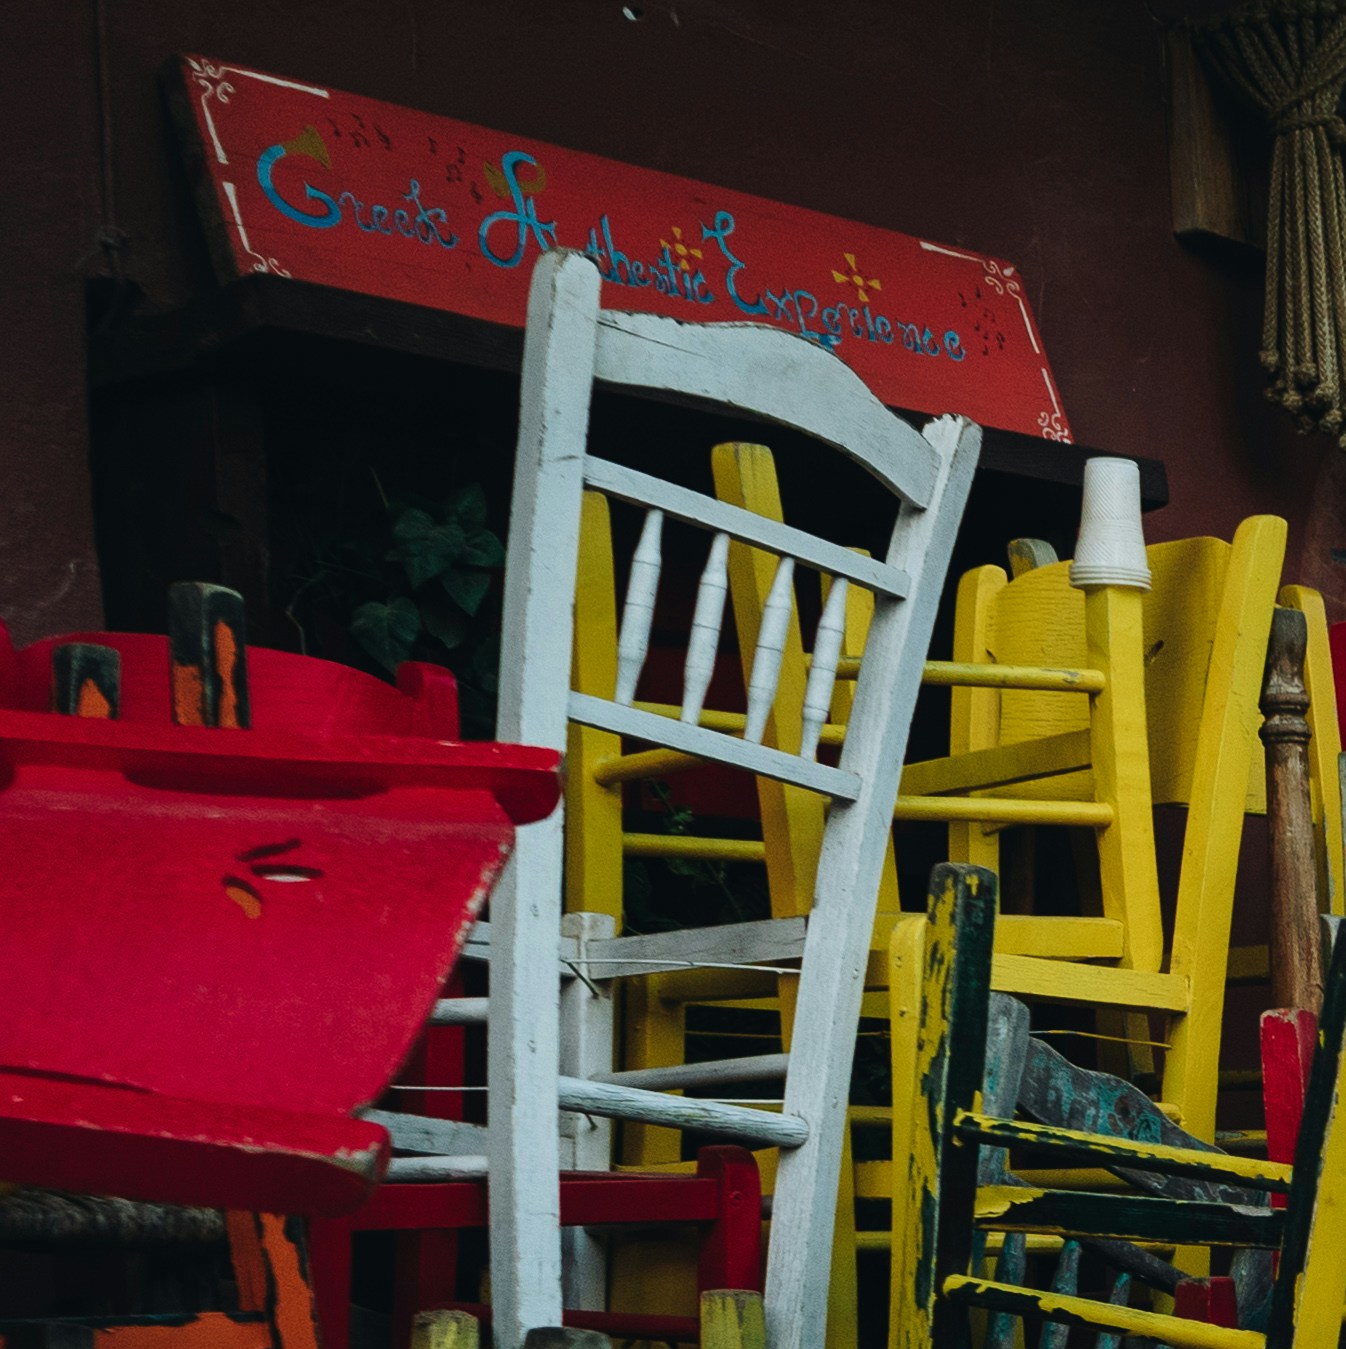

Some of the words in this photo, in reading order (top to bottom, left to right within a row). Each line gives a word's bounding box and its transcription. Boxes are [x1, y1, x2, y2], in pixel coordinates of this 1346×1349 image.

[256, 127, 460, 250] Greek
[478, 149, 715, 304] Athentic
[701, 210, 966, 362] Experience
